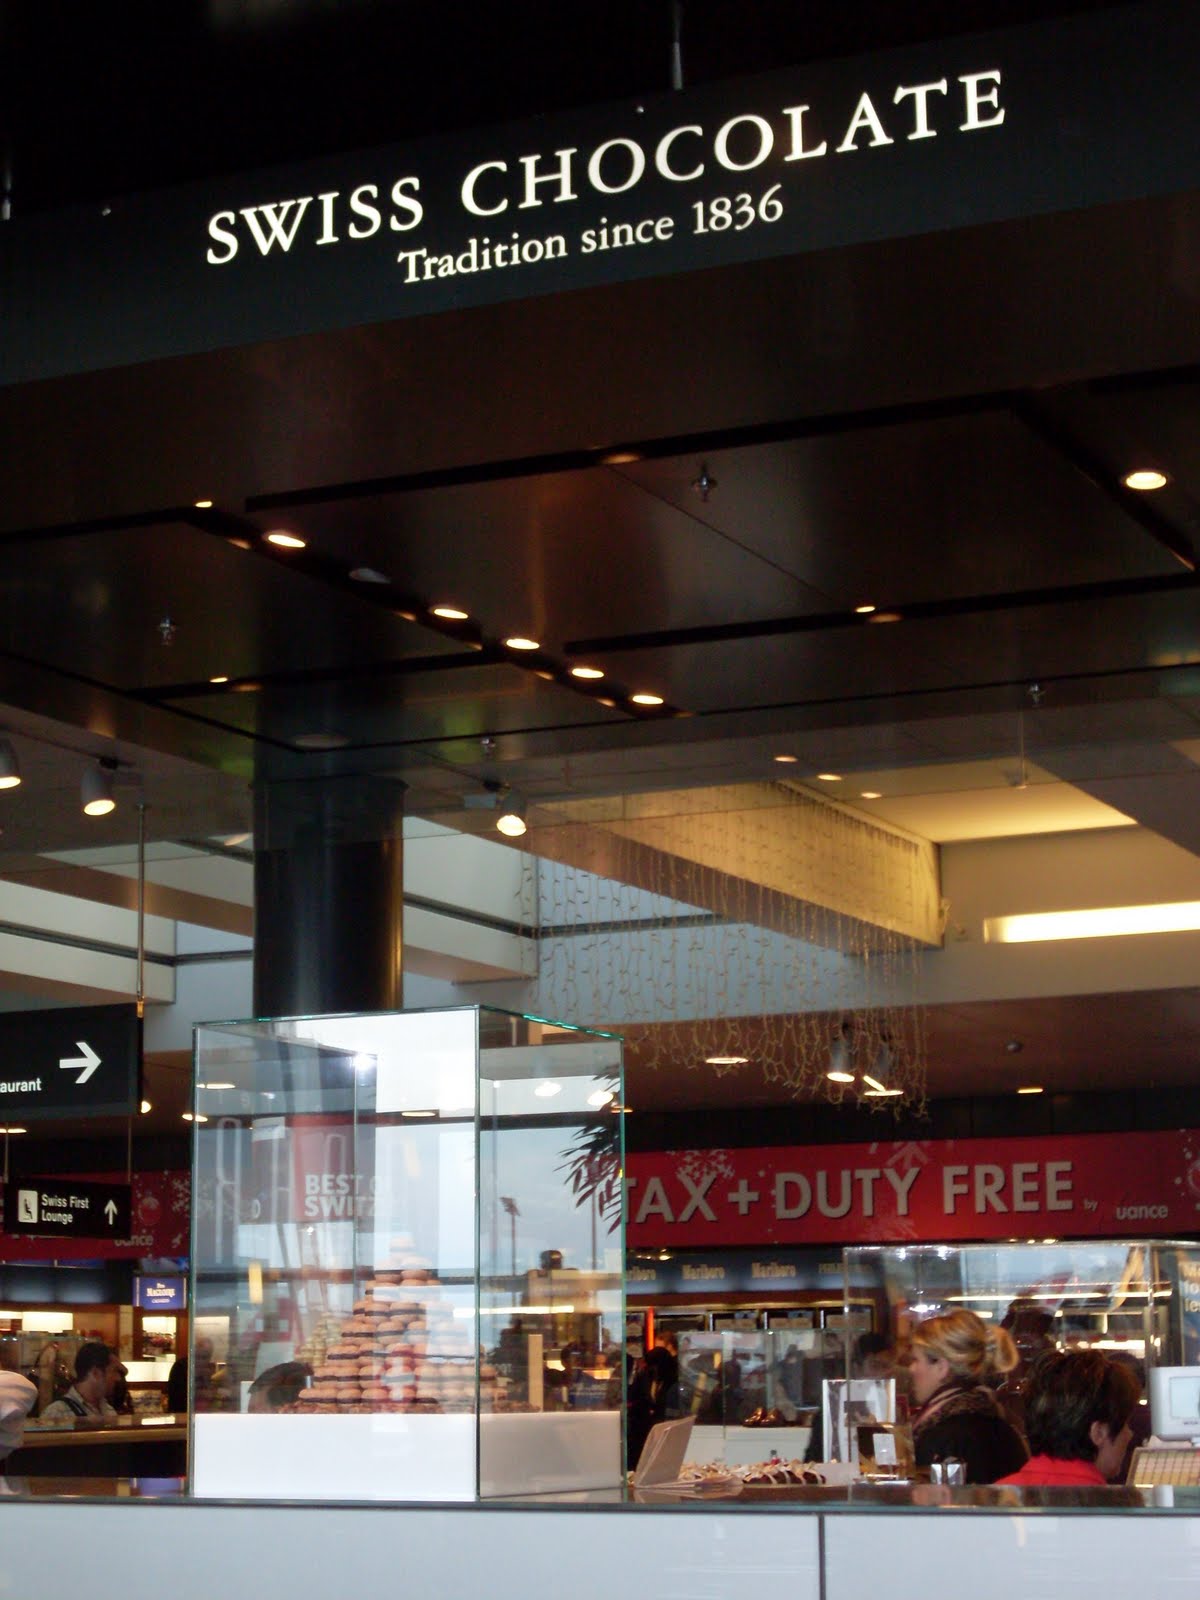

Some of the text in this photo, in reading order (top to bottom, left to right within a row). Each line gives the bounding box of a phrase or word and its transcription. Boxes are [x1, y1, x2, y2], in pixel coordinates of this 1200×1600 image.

[206, 69, 1006, 265] SWISS CHOCOLATE
[397, 183, 784, 284] Tradition since 1836
[41, 1193, 89, 1209] Swiss First
[305, 1174, 363, 1196] BEST
[625, 1174, 718, 1223] TAX
[774, 1167, 921, 1219] DUTY
[942, 1161, 1073, 1215] FREE
[1084, 1199, 1098, 1212] by
[41, 1208, 73, 1225] Lounge
